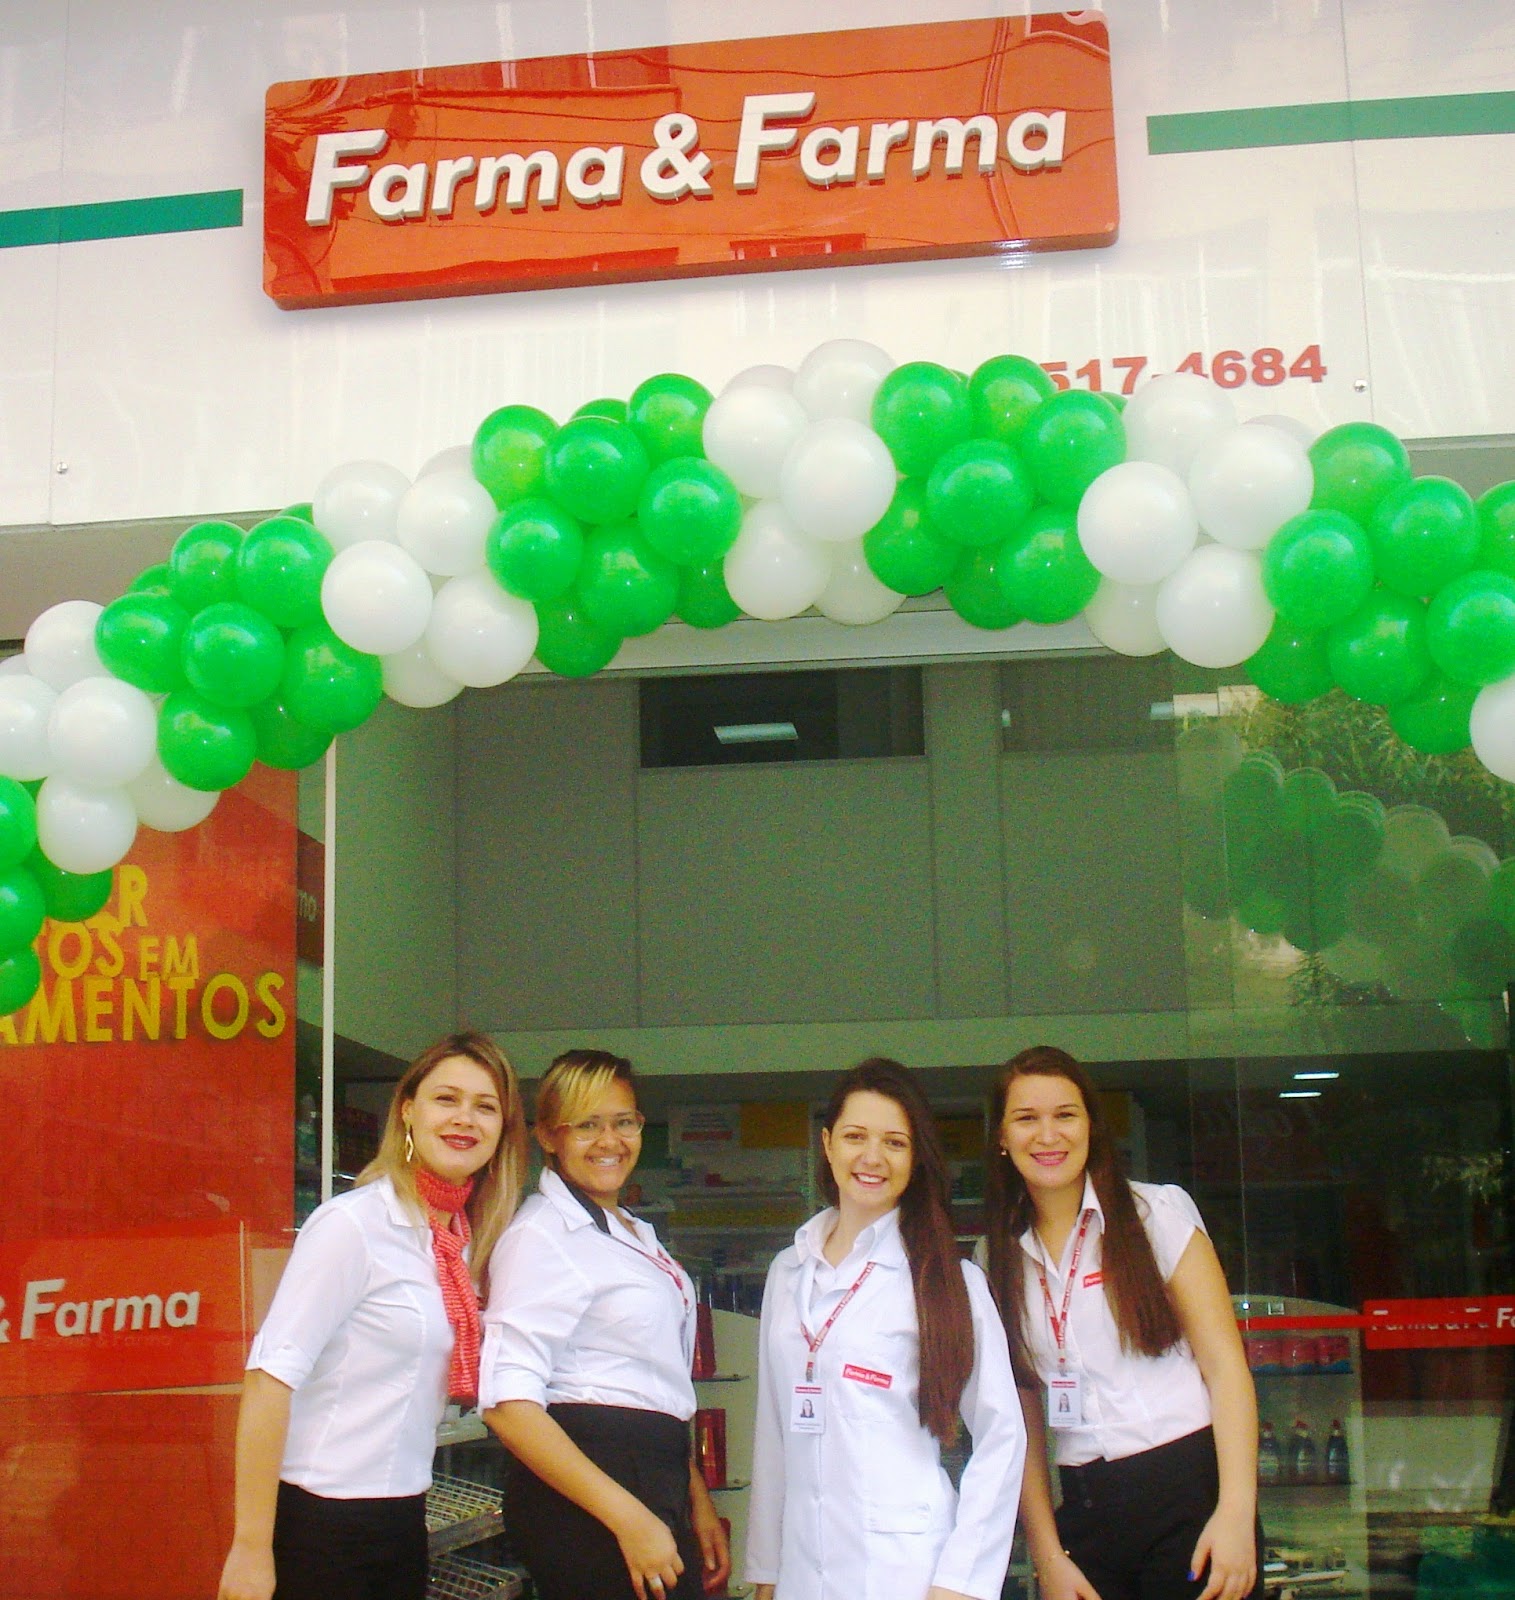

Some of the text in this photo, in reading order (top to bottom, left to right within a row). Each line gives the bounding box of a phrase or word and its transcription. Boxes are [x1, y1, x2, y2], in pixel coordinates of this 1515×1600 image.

[304, 91, 1068, 226] Farma & Farma
[1040, 344, 1328, 395] 5174684
[32, 915, 200, 982] OS EM
[20, 1278, 200, 1340] Farma
